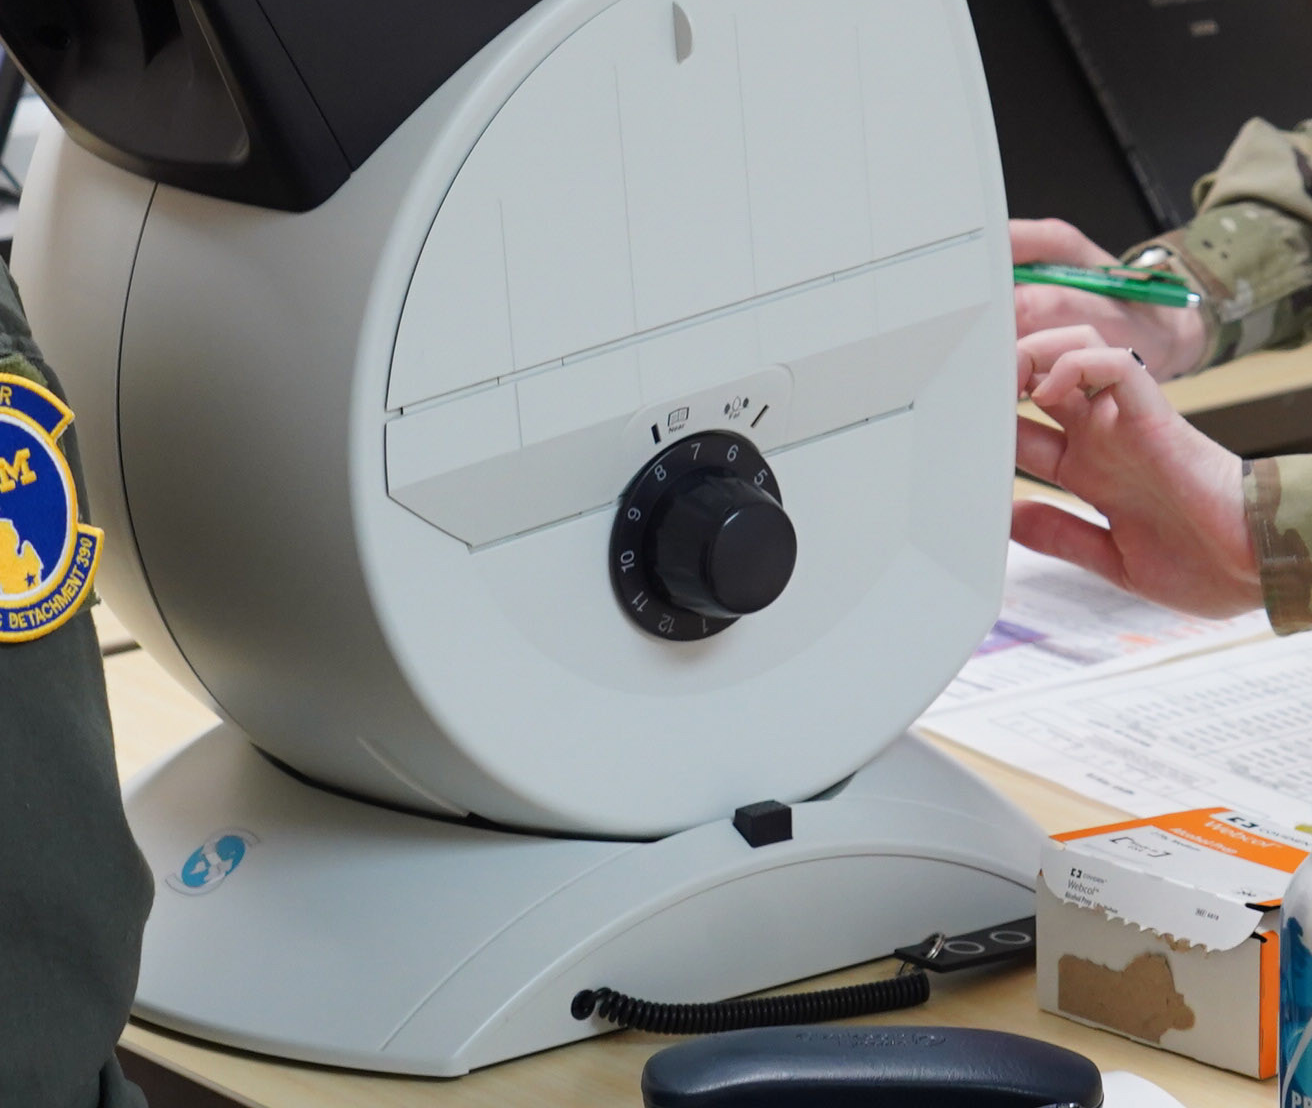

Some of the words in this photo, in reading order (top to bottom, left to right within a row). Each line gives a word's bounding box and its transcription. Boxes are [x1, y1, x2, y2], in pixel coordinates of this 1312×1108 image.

[691, 443, 701, 461] 7
[727, 445, 738, 462] 6
[654, 464, 667, 481] 8
[754, 468, 768, 486] 5
[627, 507, 641, 522] 9
[620, 550, 635, 573] 10
[8, 567, 86, 629] DETACHMENT
[76, 537, 93, 567] 390
[632, 591, 648, 613] 11
